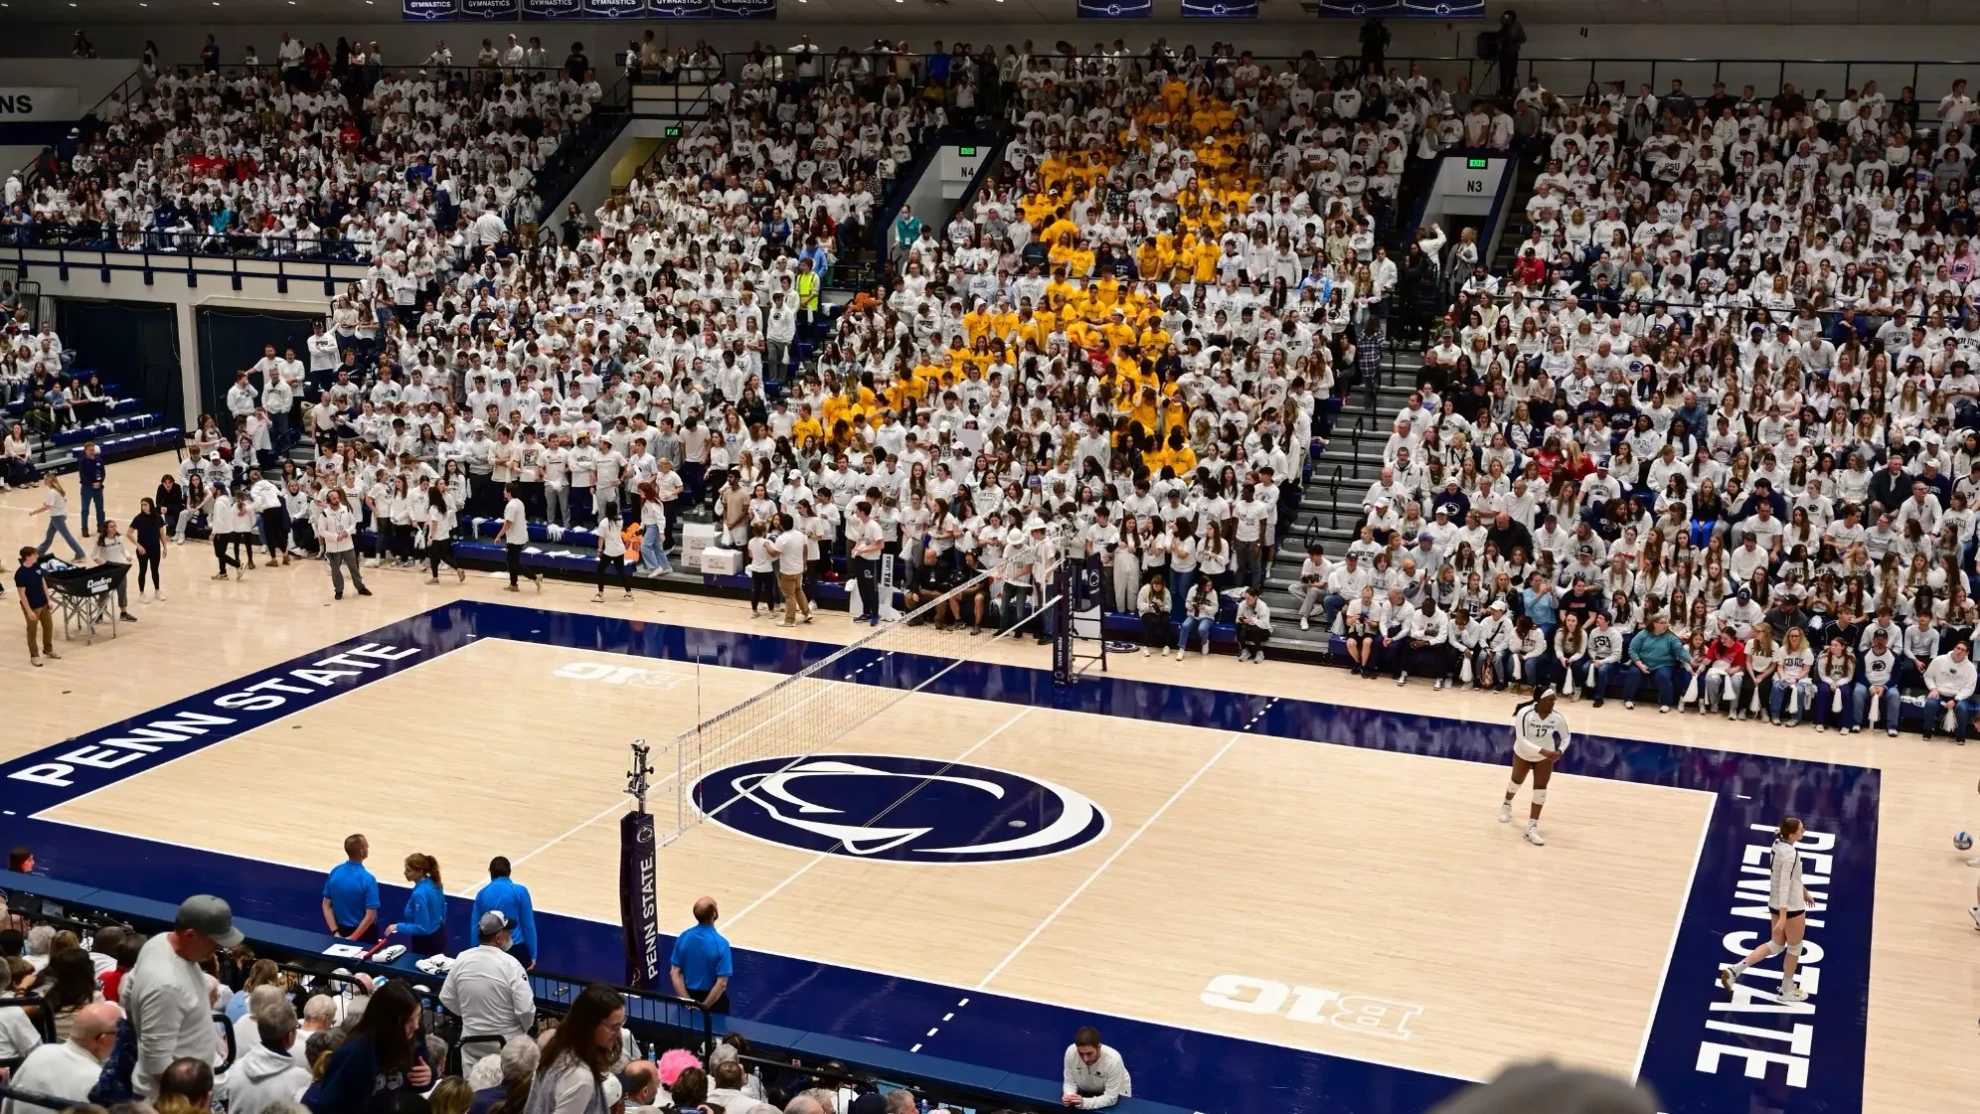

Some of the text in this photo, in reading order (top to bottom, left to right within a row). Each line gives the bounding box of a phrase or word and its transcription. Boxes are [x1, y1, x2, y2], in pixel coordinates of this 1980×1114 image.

[961, 167, 975, 178] N4
[1467, 181, 1483, 192] N3
[87, 577, 112, 588] Baden
[1594, 636, 1611, 648] PSU
[7, 642, 421, 788] PENN STATE
[1536, 728, 1548, 738] 17
[640, 856, 658, 980] PENN STATE
[1695, 824, 1836, 1088] PENN STATE
